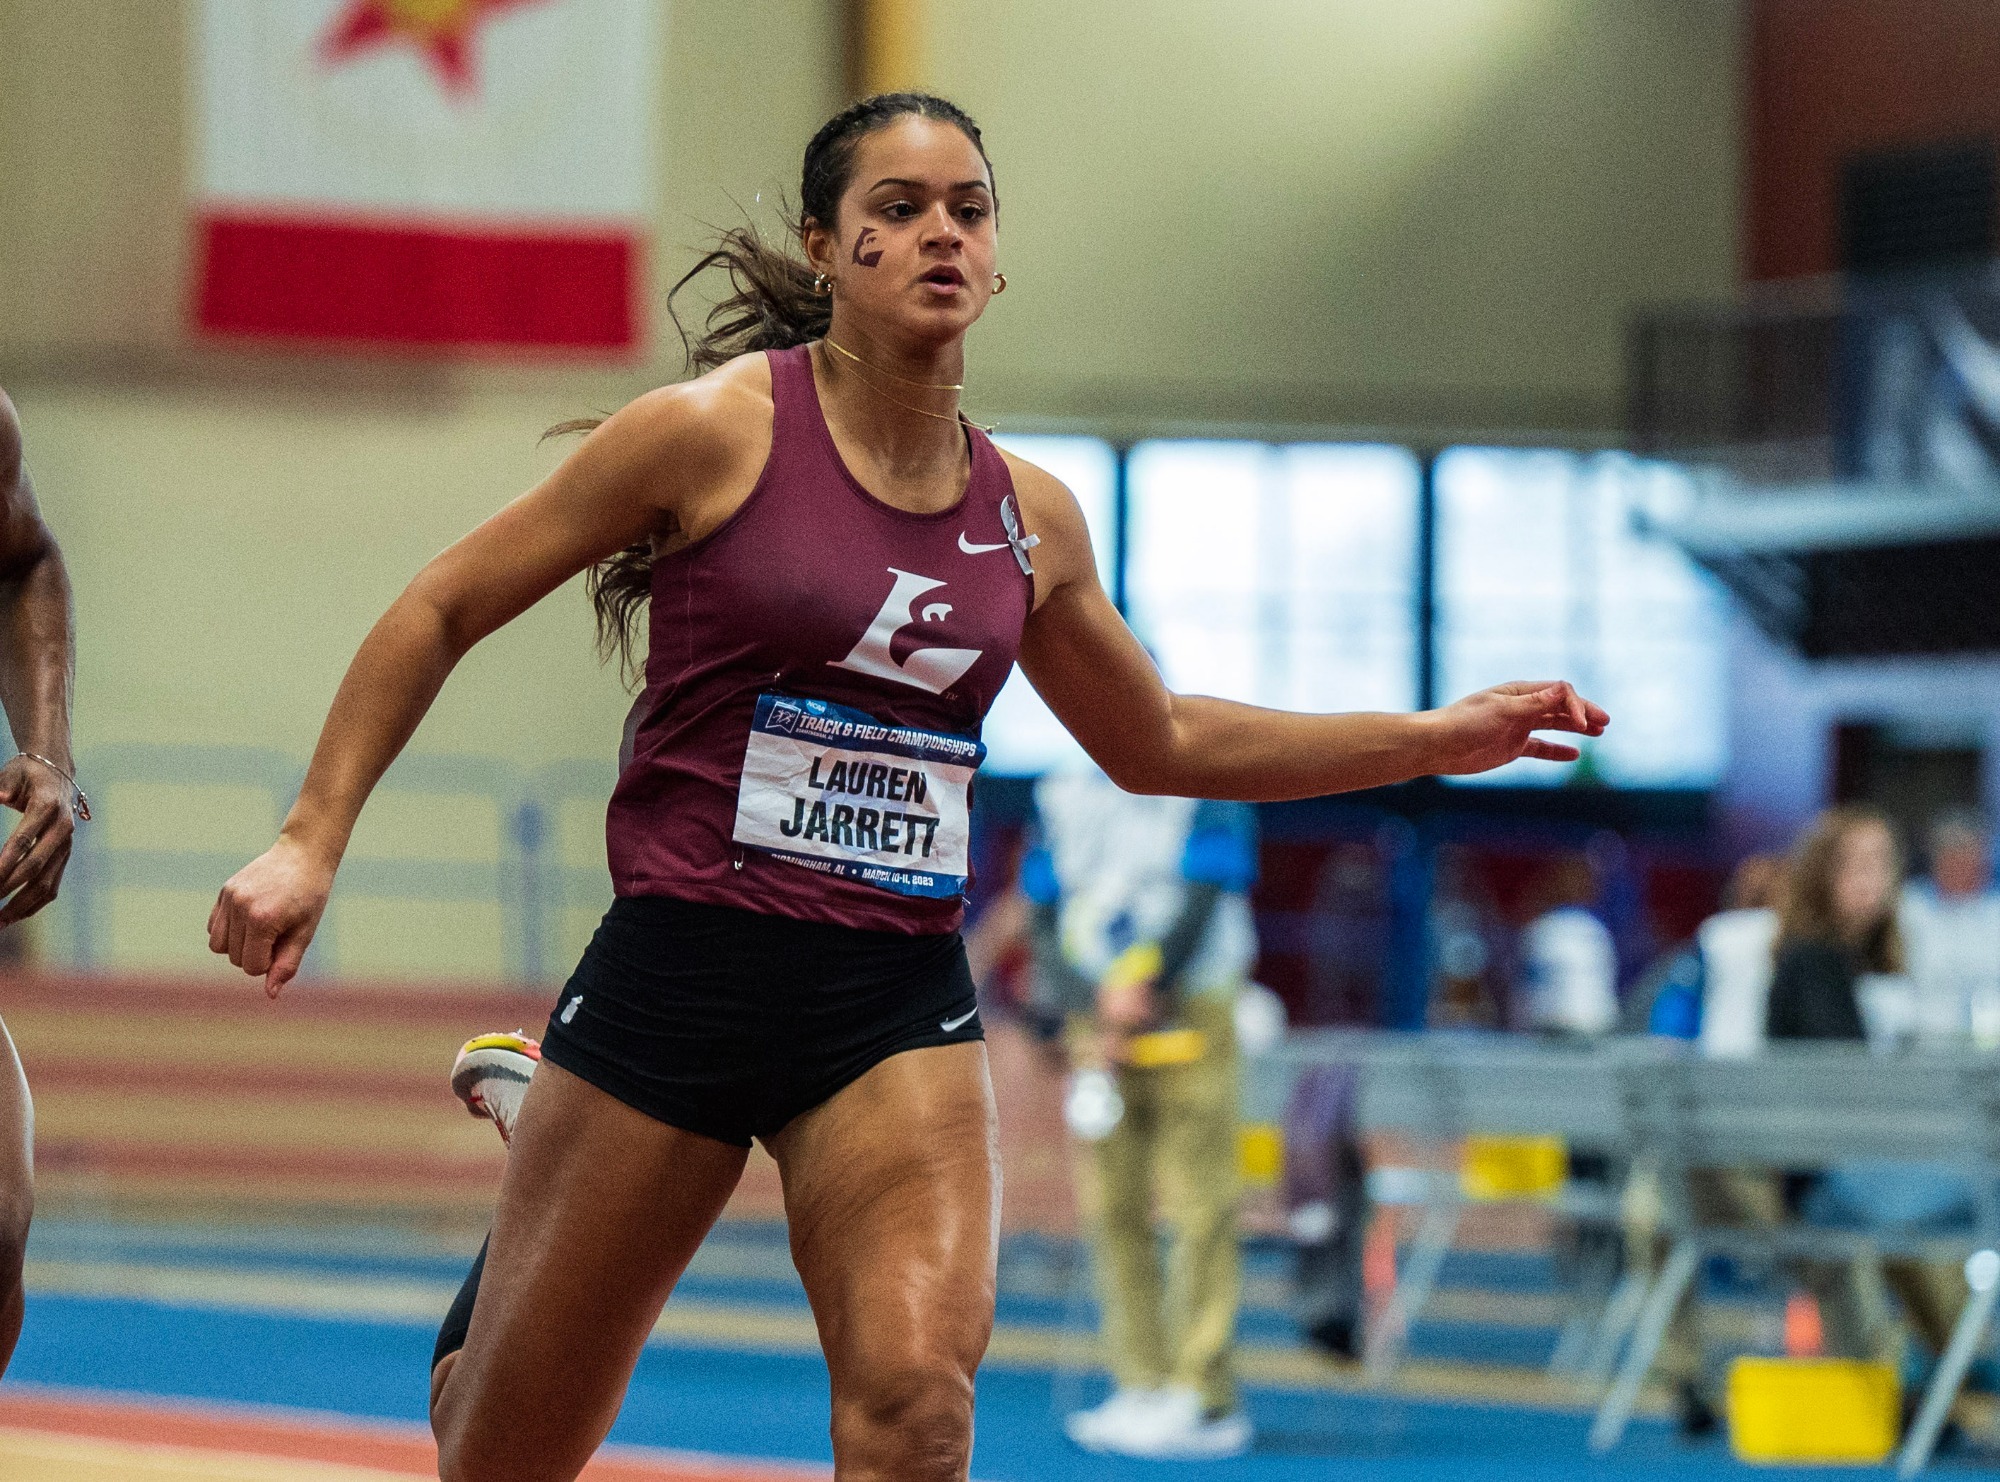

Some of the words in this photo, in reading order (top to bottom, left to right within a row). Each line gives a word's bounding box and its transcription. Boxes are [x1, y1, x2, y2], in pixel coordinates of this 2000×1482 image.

[800, 715, 842, 735] TRACK
[842, 723, 853, 737] &
[853, 724, 888, 741] FIELD
[887, 729, 977, 757] CHAMPIONSHIPS
[808, 756, 927, 804] LAUREN
[780, 797, 940, 858] JARRETT
[833, 864, 845, 875] AL
[862, 868, 891, 882] MARCH
[912, 875, 934, 887] 2023
